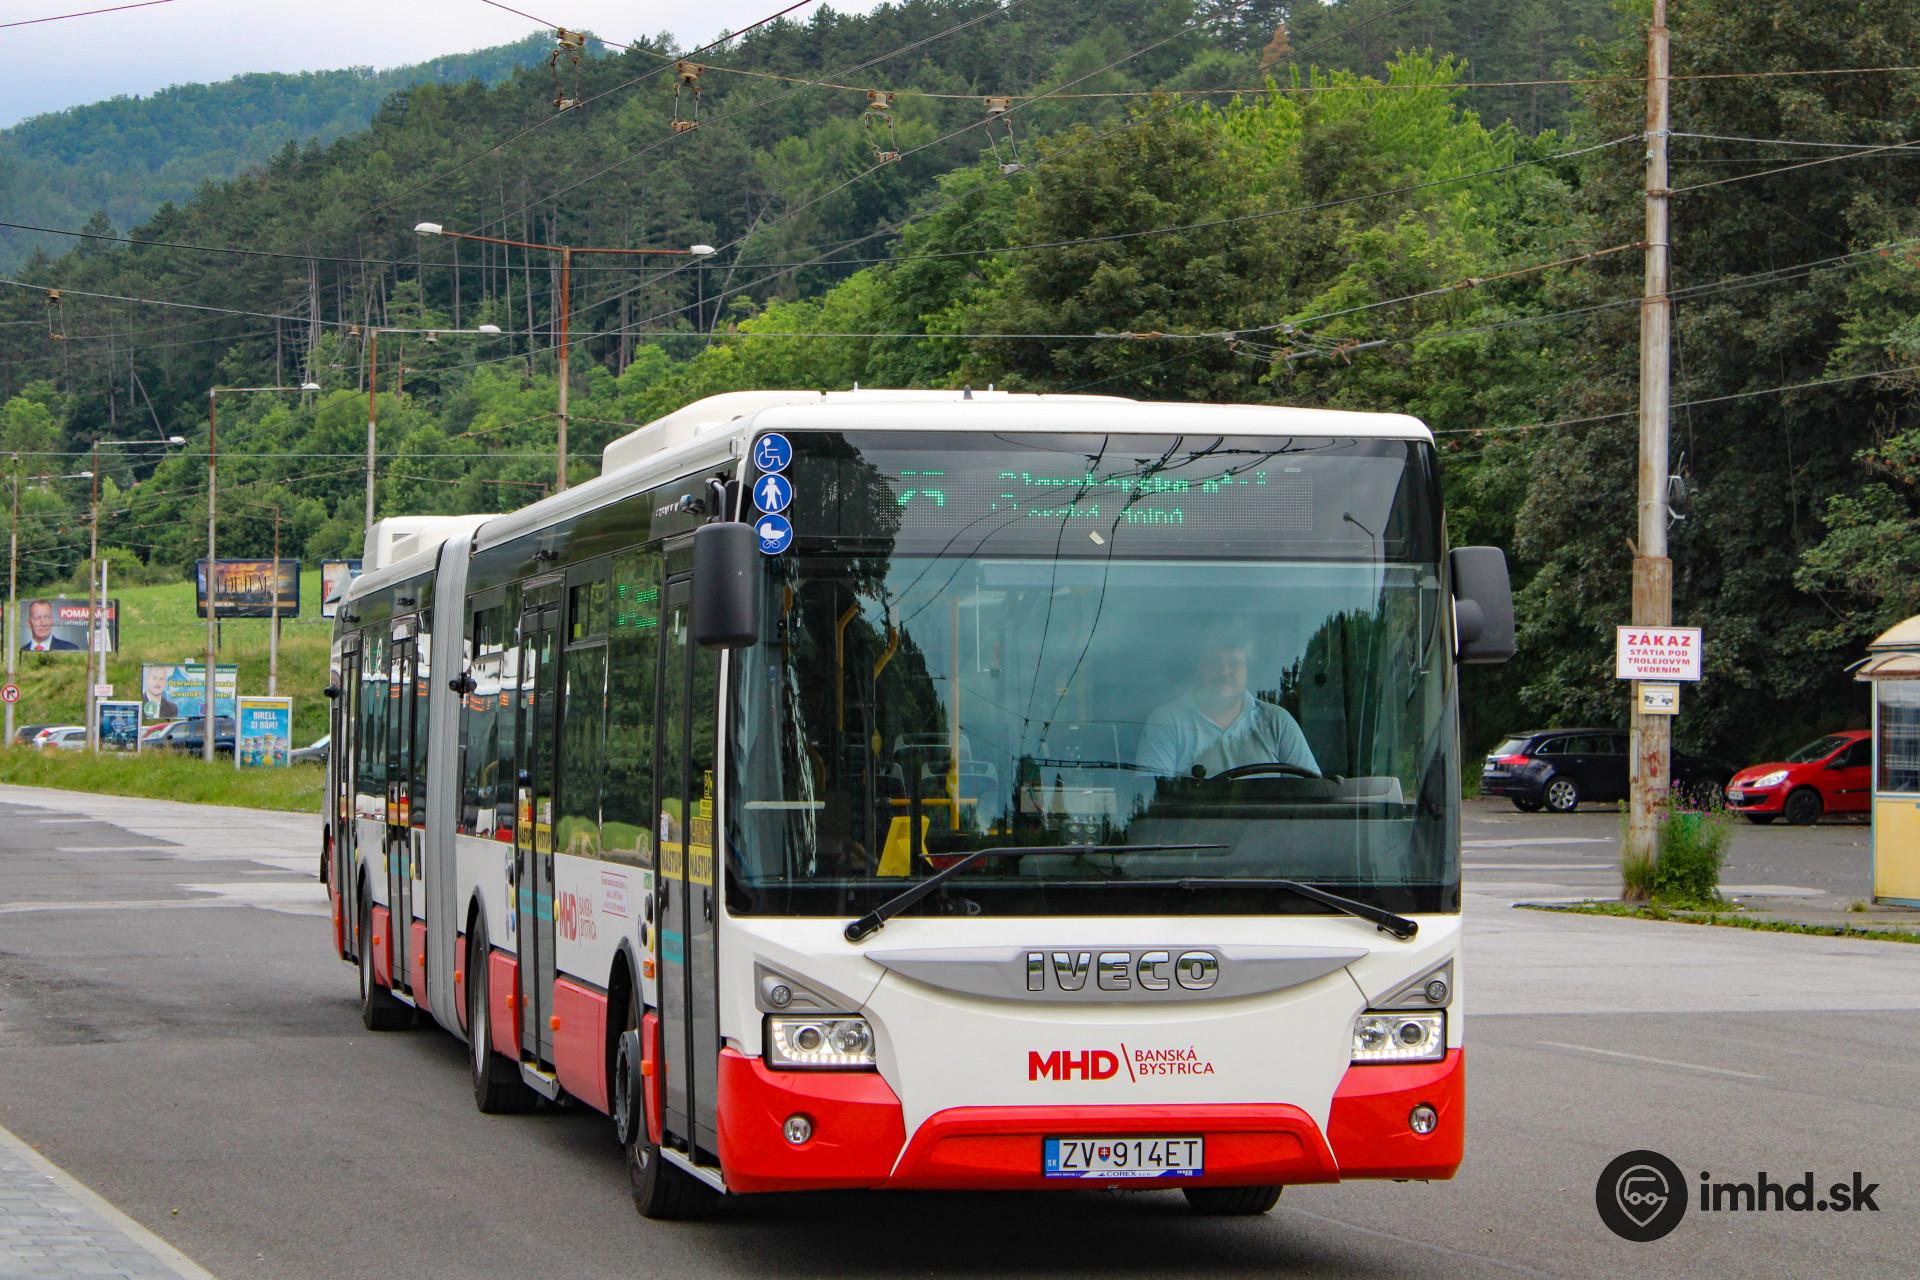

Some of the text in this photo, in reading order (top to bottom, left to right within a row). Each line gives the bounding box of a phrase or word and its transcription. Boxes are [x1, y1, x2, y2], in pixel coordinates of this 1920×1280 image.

[1627, 632, 1691, 647] ZÁKAZ
[1668, 649, 1688, 657] POD
[1027, 951, 1219, 991] IVECO
[1135, 1045, 1198, 1062] BANSKÁ
[1028, 1050, 1120, 1081] MHD
[1139, 1062, 1215, 1075] BYSTRICA
[1062, 1142, 1096, 1168] ZV
[1113, 1141, 1198, 1167] 914ET
